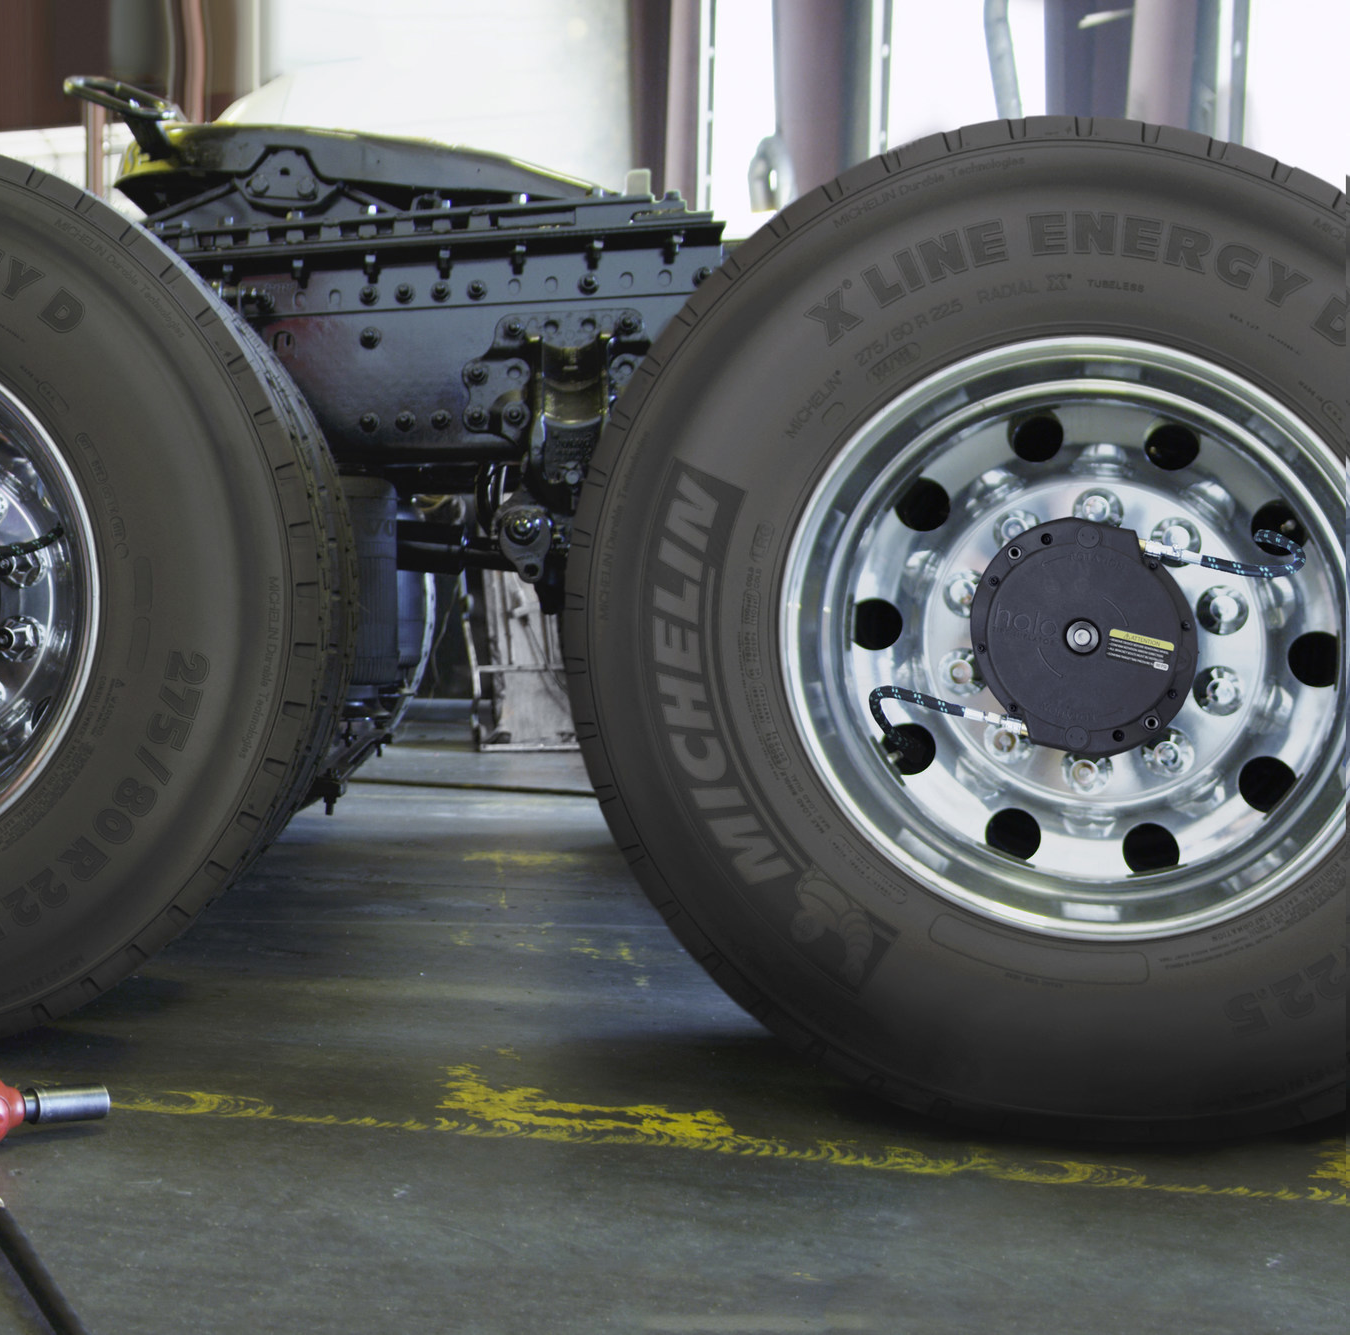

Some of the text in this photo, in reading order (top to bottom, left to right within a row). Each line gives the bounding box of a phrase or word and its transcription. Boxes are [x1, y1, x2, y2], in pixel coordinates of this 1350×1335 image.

[829, 185, 896, 226] MICHELIN
[53, 214, 110, 254] MICHELIN
[860, 217, 1009, 309] LINE
[1026, 210, 1312, 307] ENERGY
[36, 286, 87, 336] D
[975, 277, 1039, 305] RADIAL
[1086, 278, 1145, 293] TUBELESS
[782, 372, 843, 440] MICHELIN
[269, 576, 283, 640] MICHELIN
[594, 552, 612, 620] MICHELIN
[993, 601, 1058, 638] halo
[1130, 635, 1161, 648] ATTENTION
[650, 473, 791, 884] MICHELIN
[96, 650, 211, 844] 275/80
[63, 833, 113, 887] R
